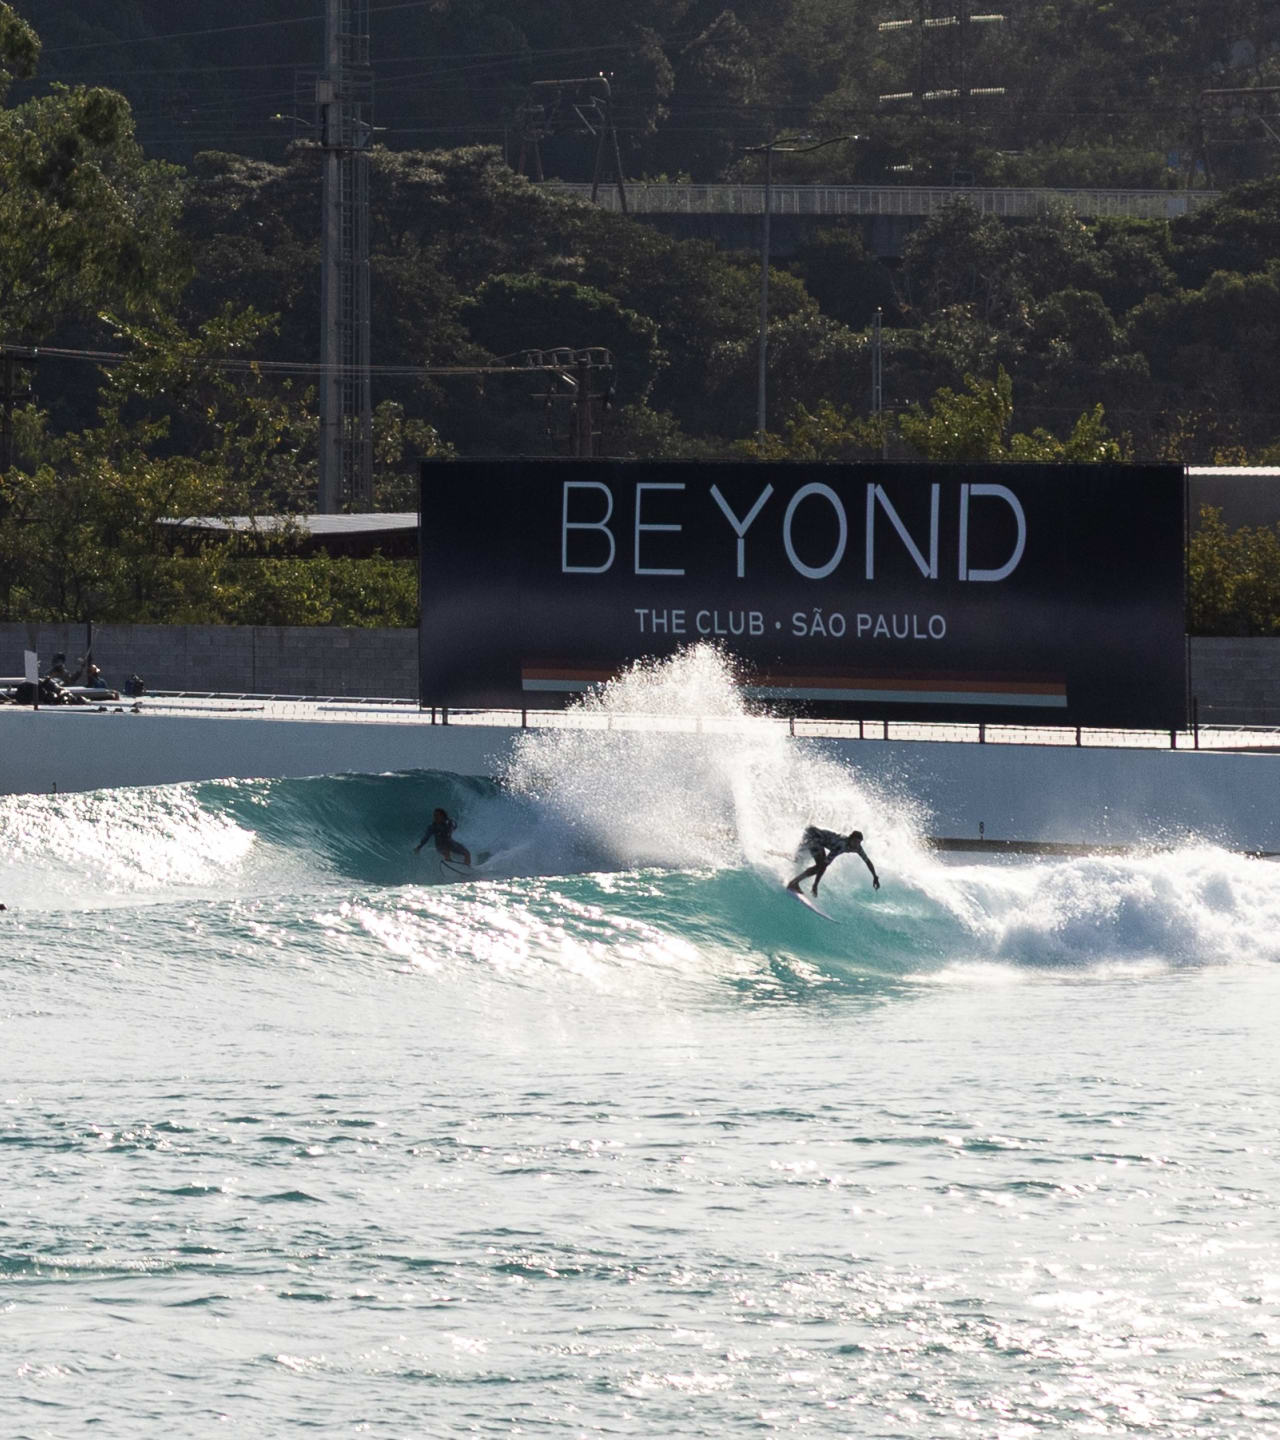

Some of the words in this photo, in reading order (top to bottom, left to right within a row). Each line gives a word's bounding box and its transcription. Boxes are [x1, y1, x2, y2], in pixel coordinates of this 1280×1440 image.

[562, 482, 1026, 582] BEYOND
[634, 609, 686, 633] THE
[696, 610, 764, 635] CLUB
[792, 608, 846, 637] SÃO
[857, 613, 946, 639] PAULO
